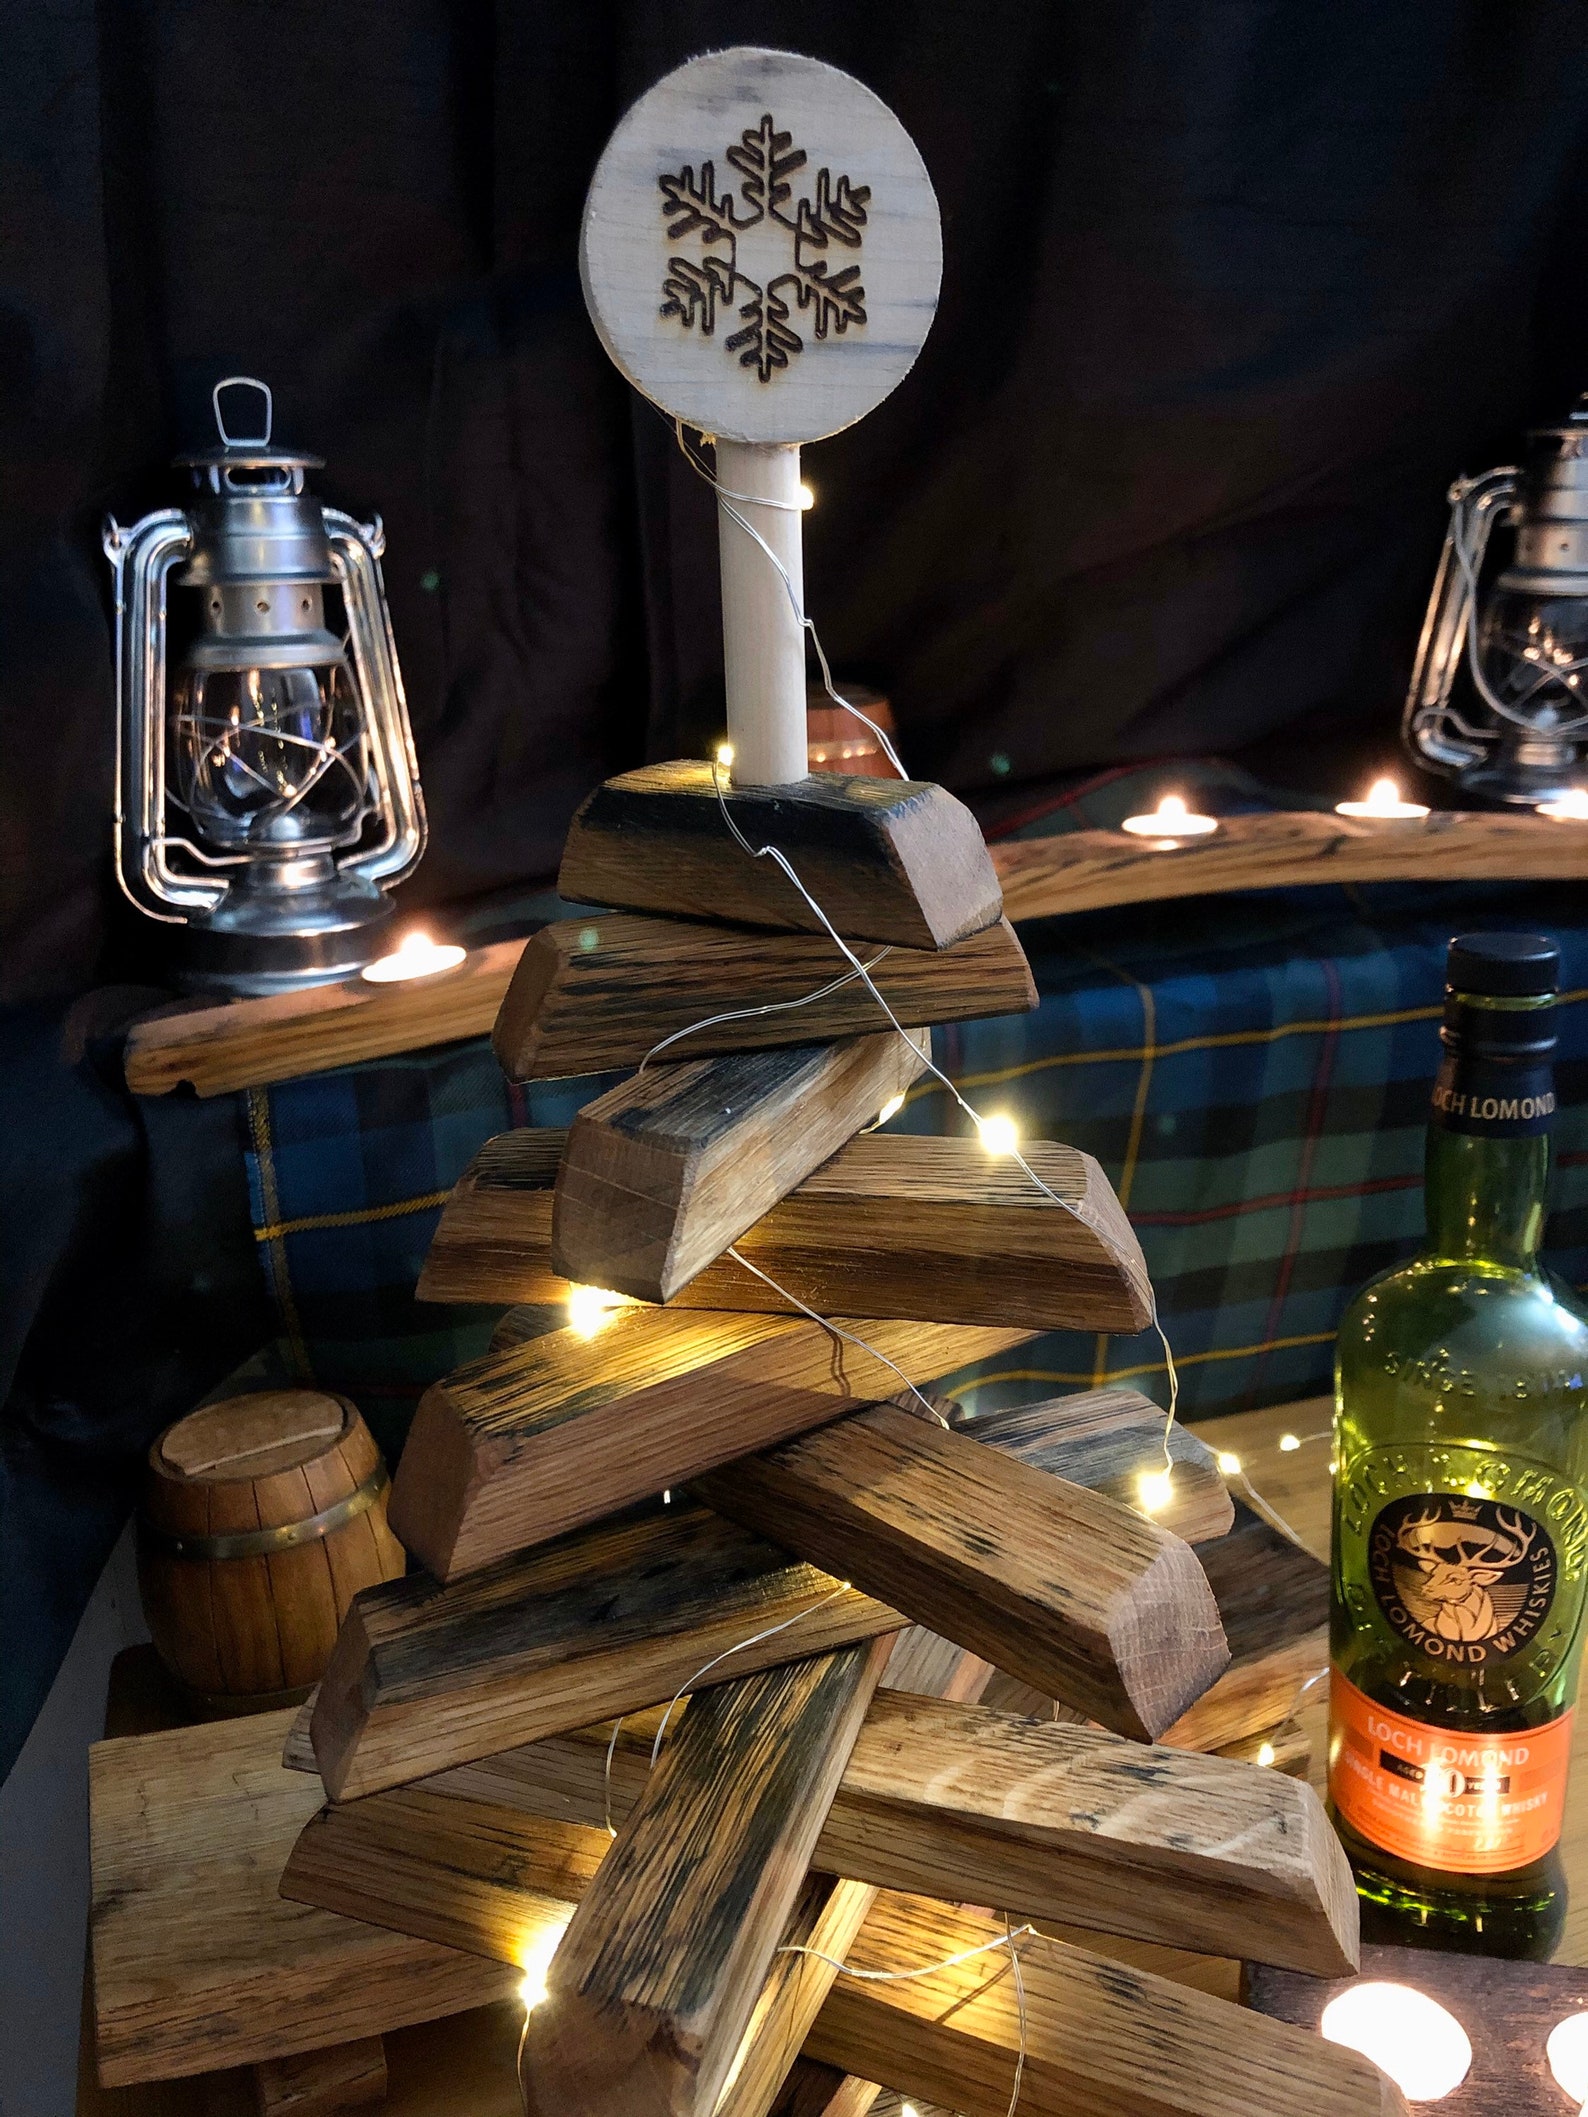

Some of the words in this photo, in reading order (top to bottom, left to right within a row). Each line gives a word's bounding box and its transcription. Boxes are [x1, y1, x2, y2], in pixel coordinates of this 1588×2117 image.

[1431, 1086, 1466, 1115] OCH
[1470, 1091, 1556, 1120] LOMOND
[1374, 1523, 1397, 1583] LOCH
[1381, 1595, 1487, 1663] LOMOND
[1491, 1547, 1551, 1654] WHISKIES
[1367, 1716, 1422, 1756] LOCH
[1430, 1743, 1530, 1767] LOMOND
[1345, 1750, 1383, 1790] SINGLE
[1388, 1775, 1424, 1807] MAL
[1501, 1791, 1548, 1816] WHISKY
